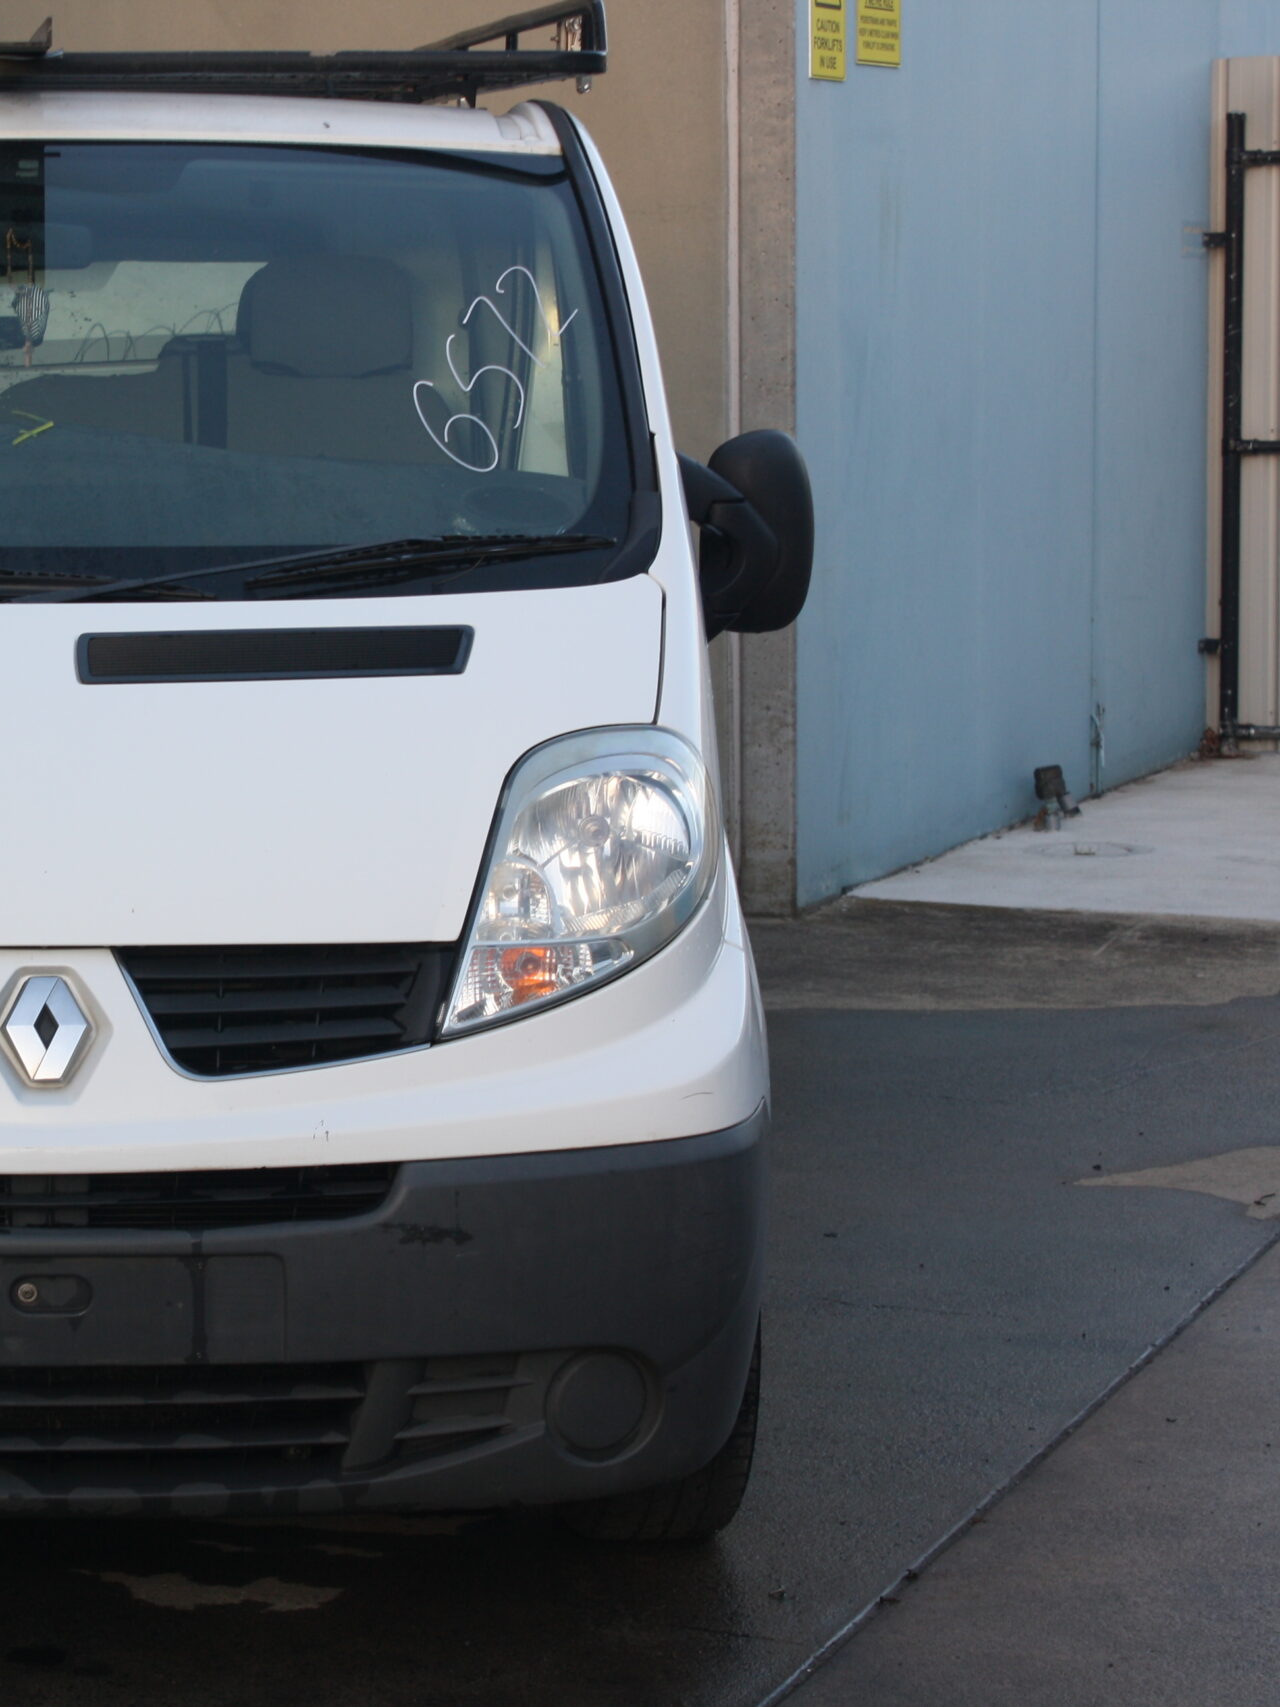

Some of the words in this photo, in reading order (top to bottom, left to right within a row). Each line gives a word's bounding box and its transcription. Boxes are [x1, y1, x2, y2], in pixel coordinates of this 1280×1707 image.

[816, 18, 840, 33] CAUTION
[813, 36, 843, 52] FORKLIFTS
[828, 56, 837, 70] USE
